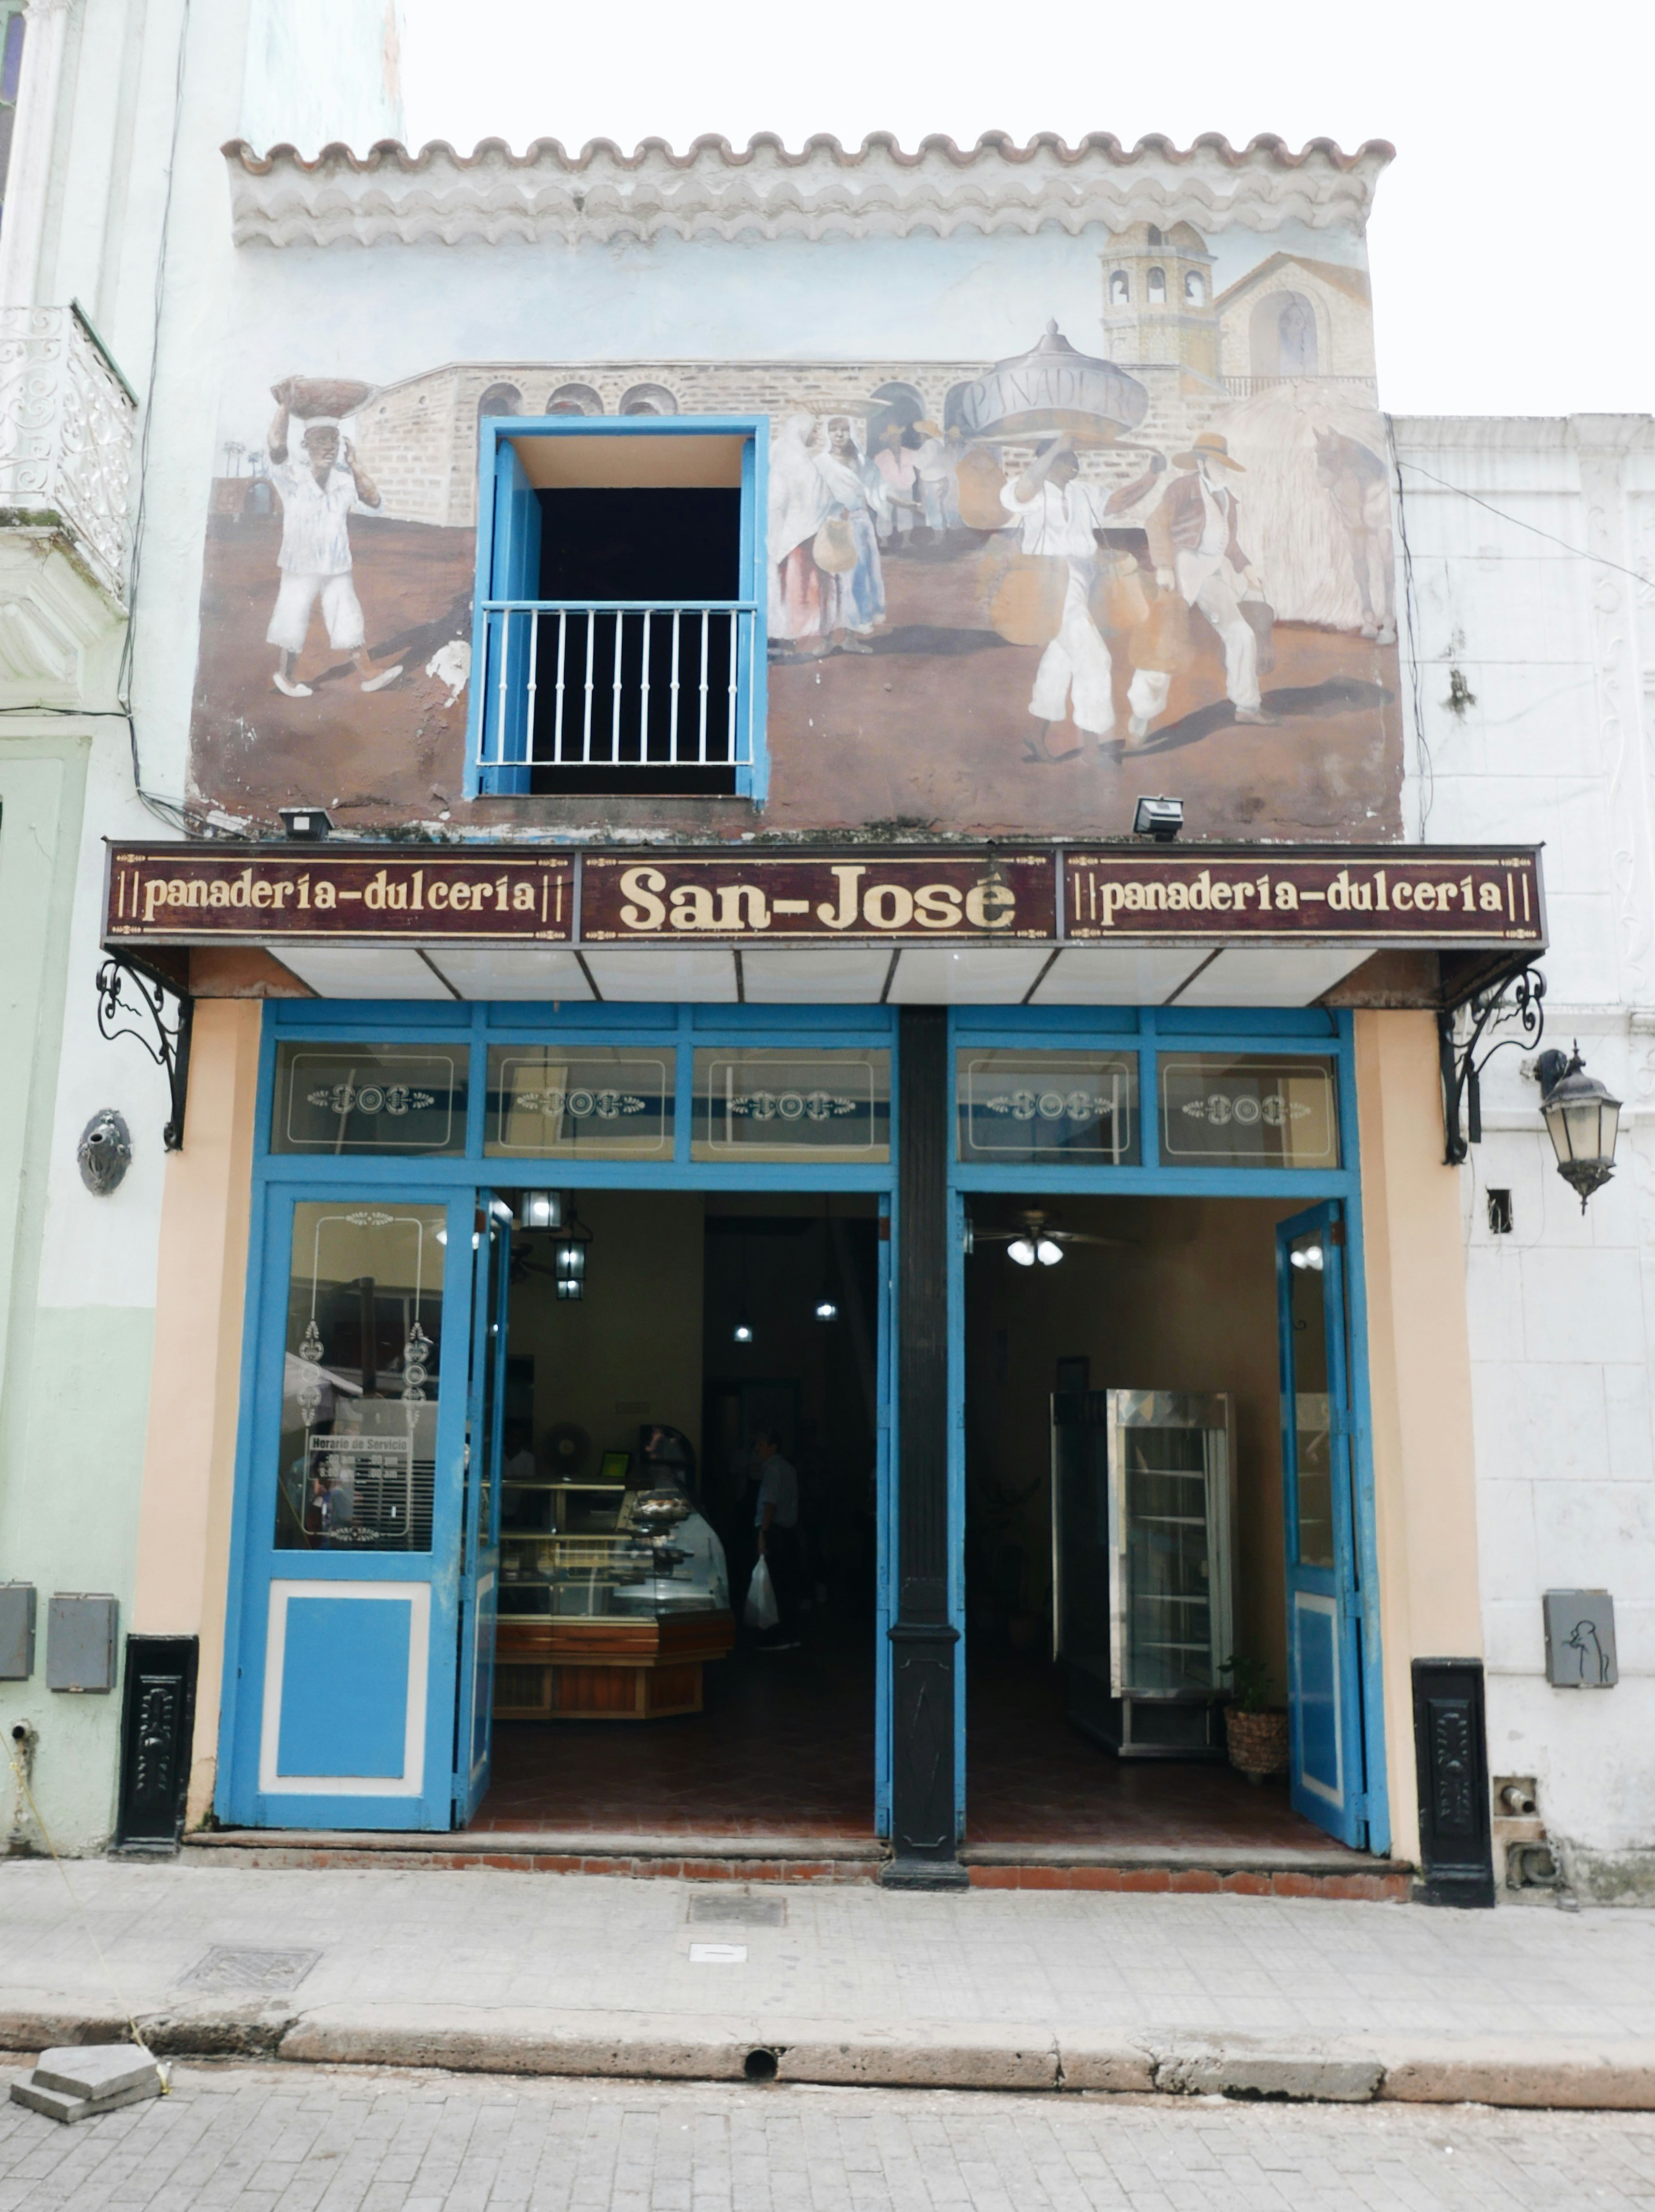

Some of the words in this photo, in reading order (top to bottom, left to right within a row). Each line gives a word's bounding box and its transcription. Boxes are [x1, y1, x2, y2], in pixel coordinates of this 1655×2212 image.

[143, 868, 536, 922] panadería-dulcería
[619, 866, 1016, 929] San-José
[1100, 870, 1504, 926] panadería-dulcería
[313, 1437, 349, 1448] Horario
[352, 1439, 364, 1449] de
[367, 1439, 407, 1450] Servicio
